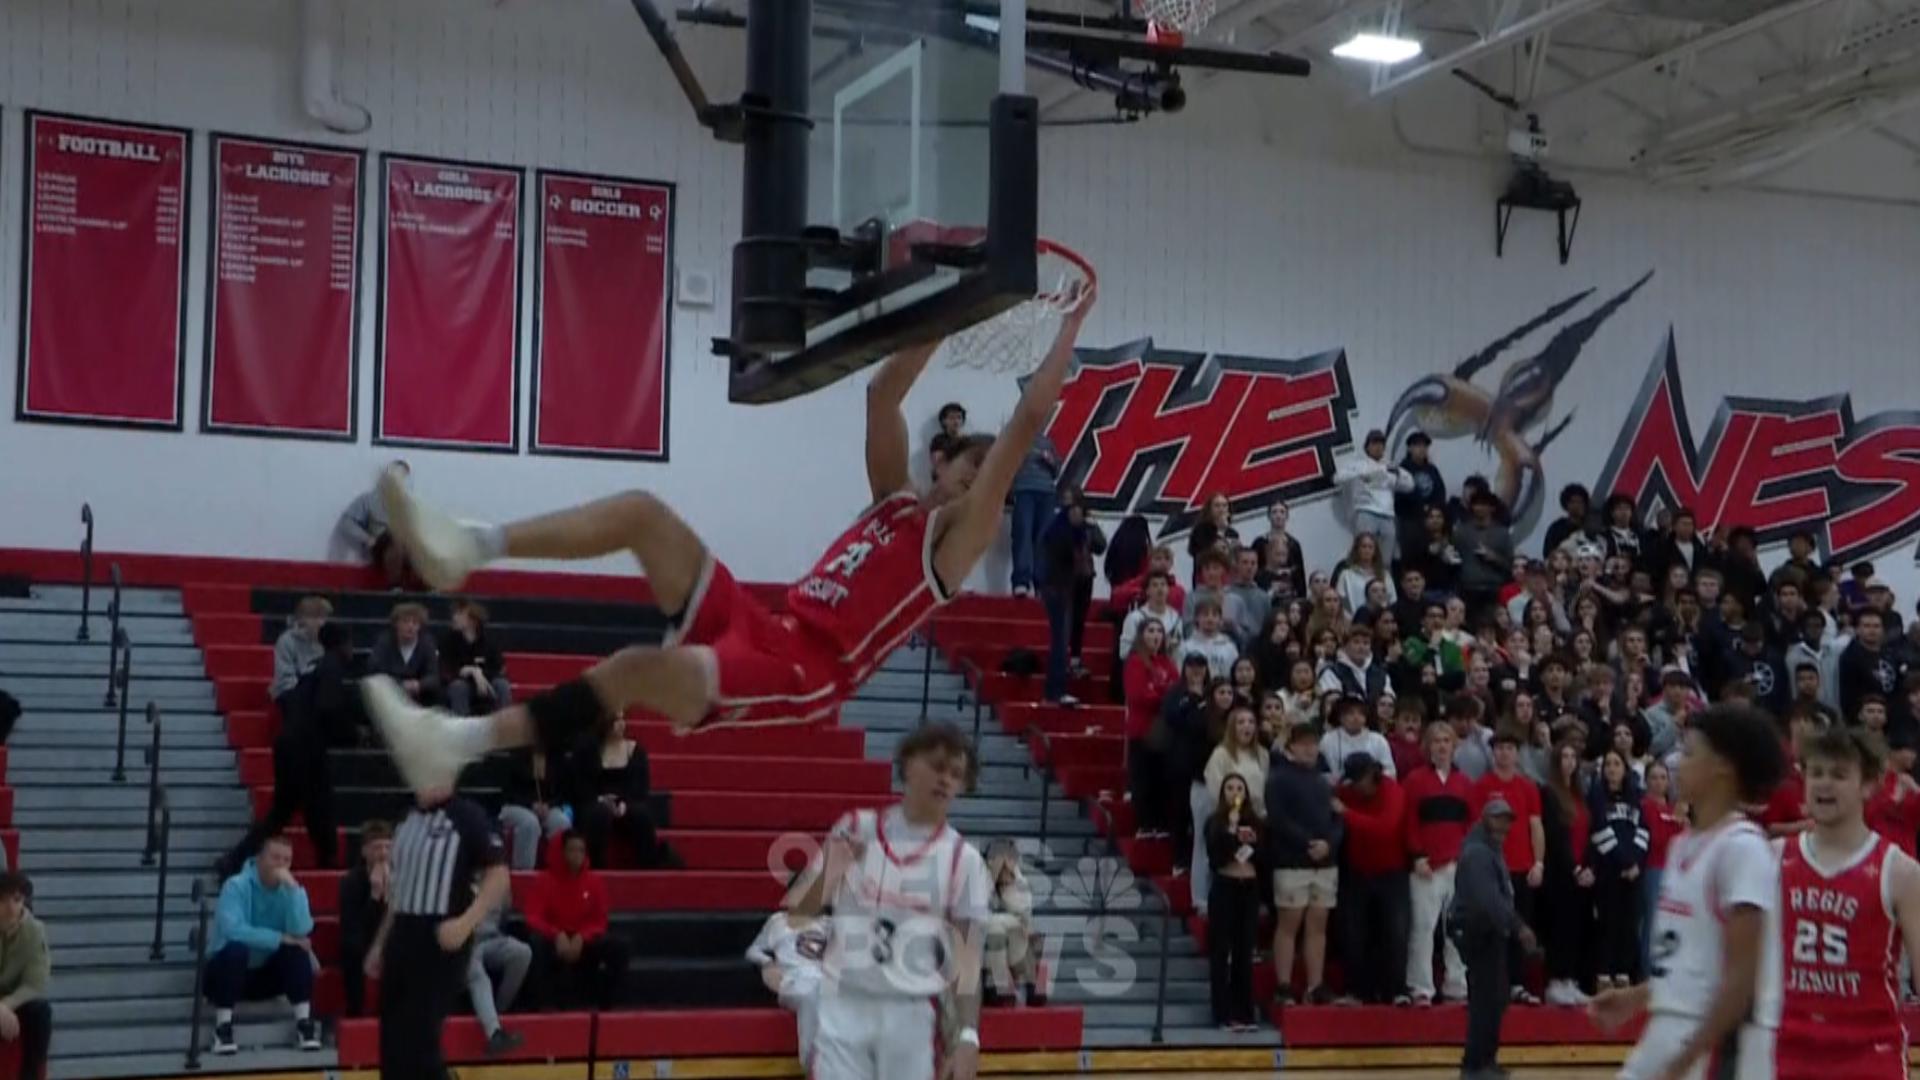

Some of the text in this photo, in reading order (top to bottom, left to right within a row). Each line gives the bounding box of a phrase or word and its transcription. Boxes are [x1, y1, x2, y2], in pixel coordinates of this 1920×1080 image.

[58, 133, 160, 161] FOOTBALL
[245, 164, 330, 186] LACROSSE
[413, 181, 492, 203] LACROSSE
[570, 198, 641, 219] SOCCER
[1030, 345, 1350, 520] THE
[1789, 886, 1859, 922] REGIS
[1793, 920, 1849, 965] 25
[1787, 968, 1860, 997] JESUIT
